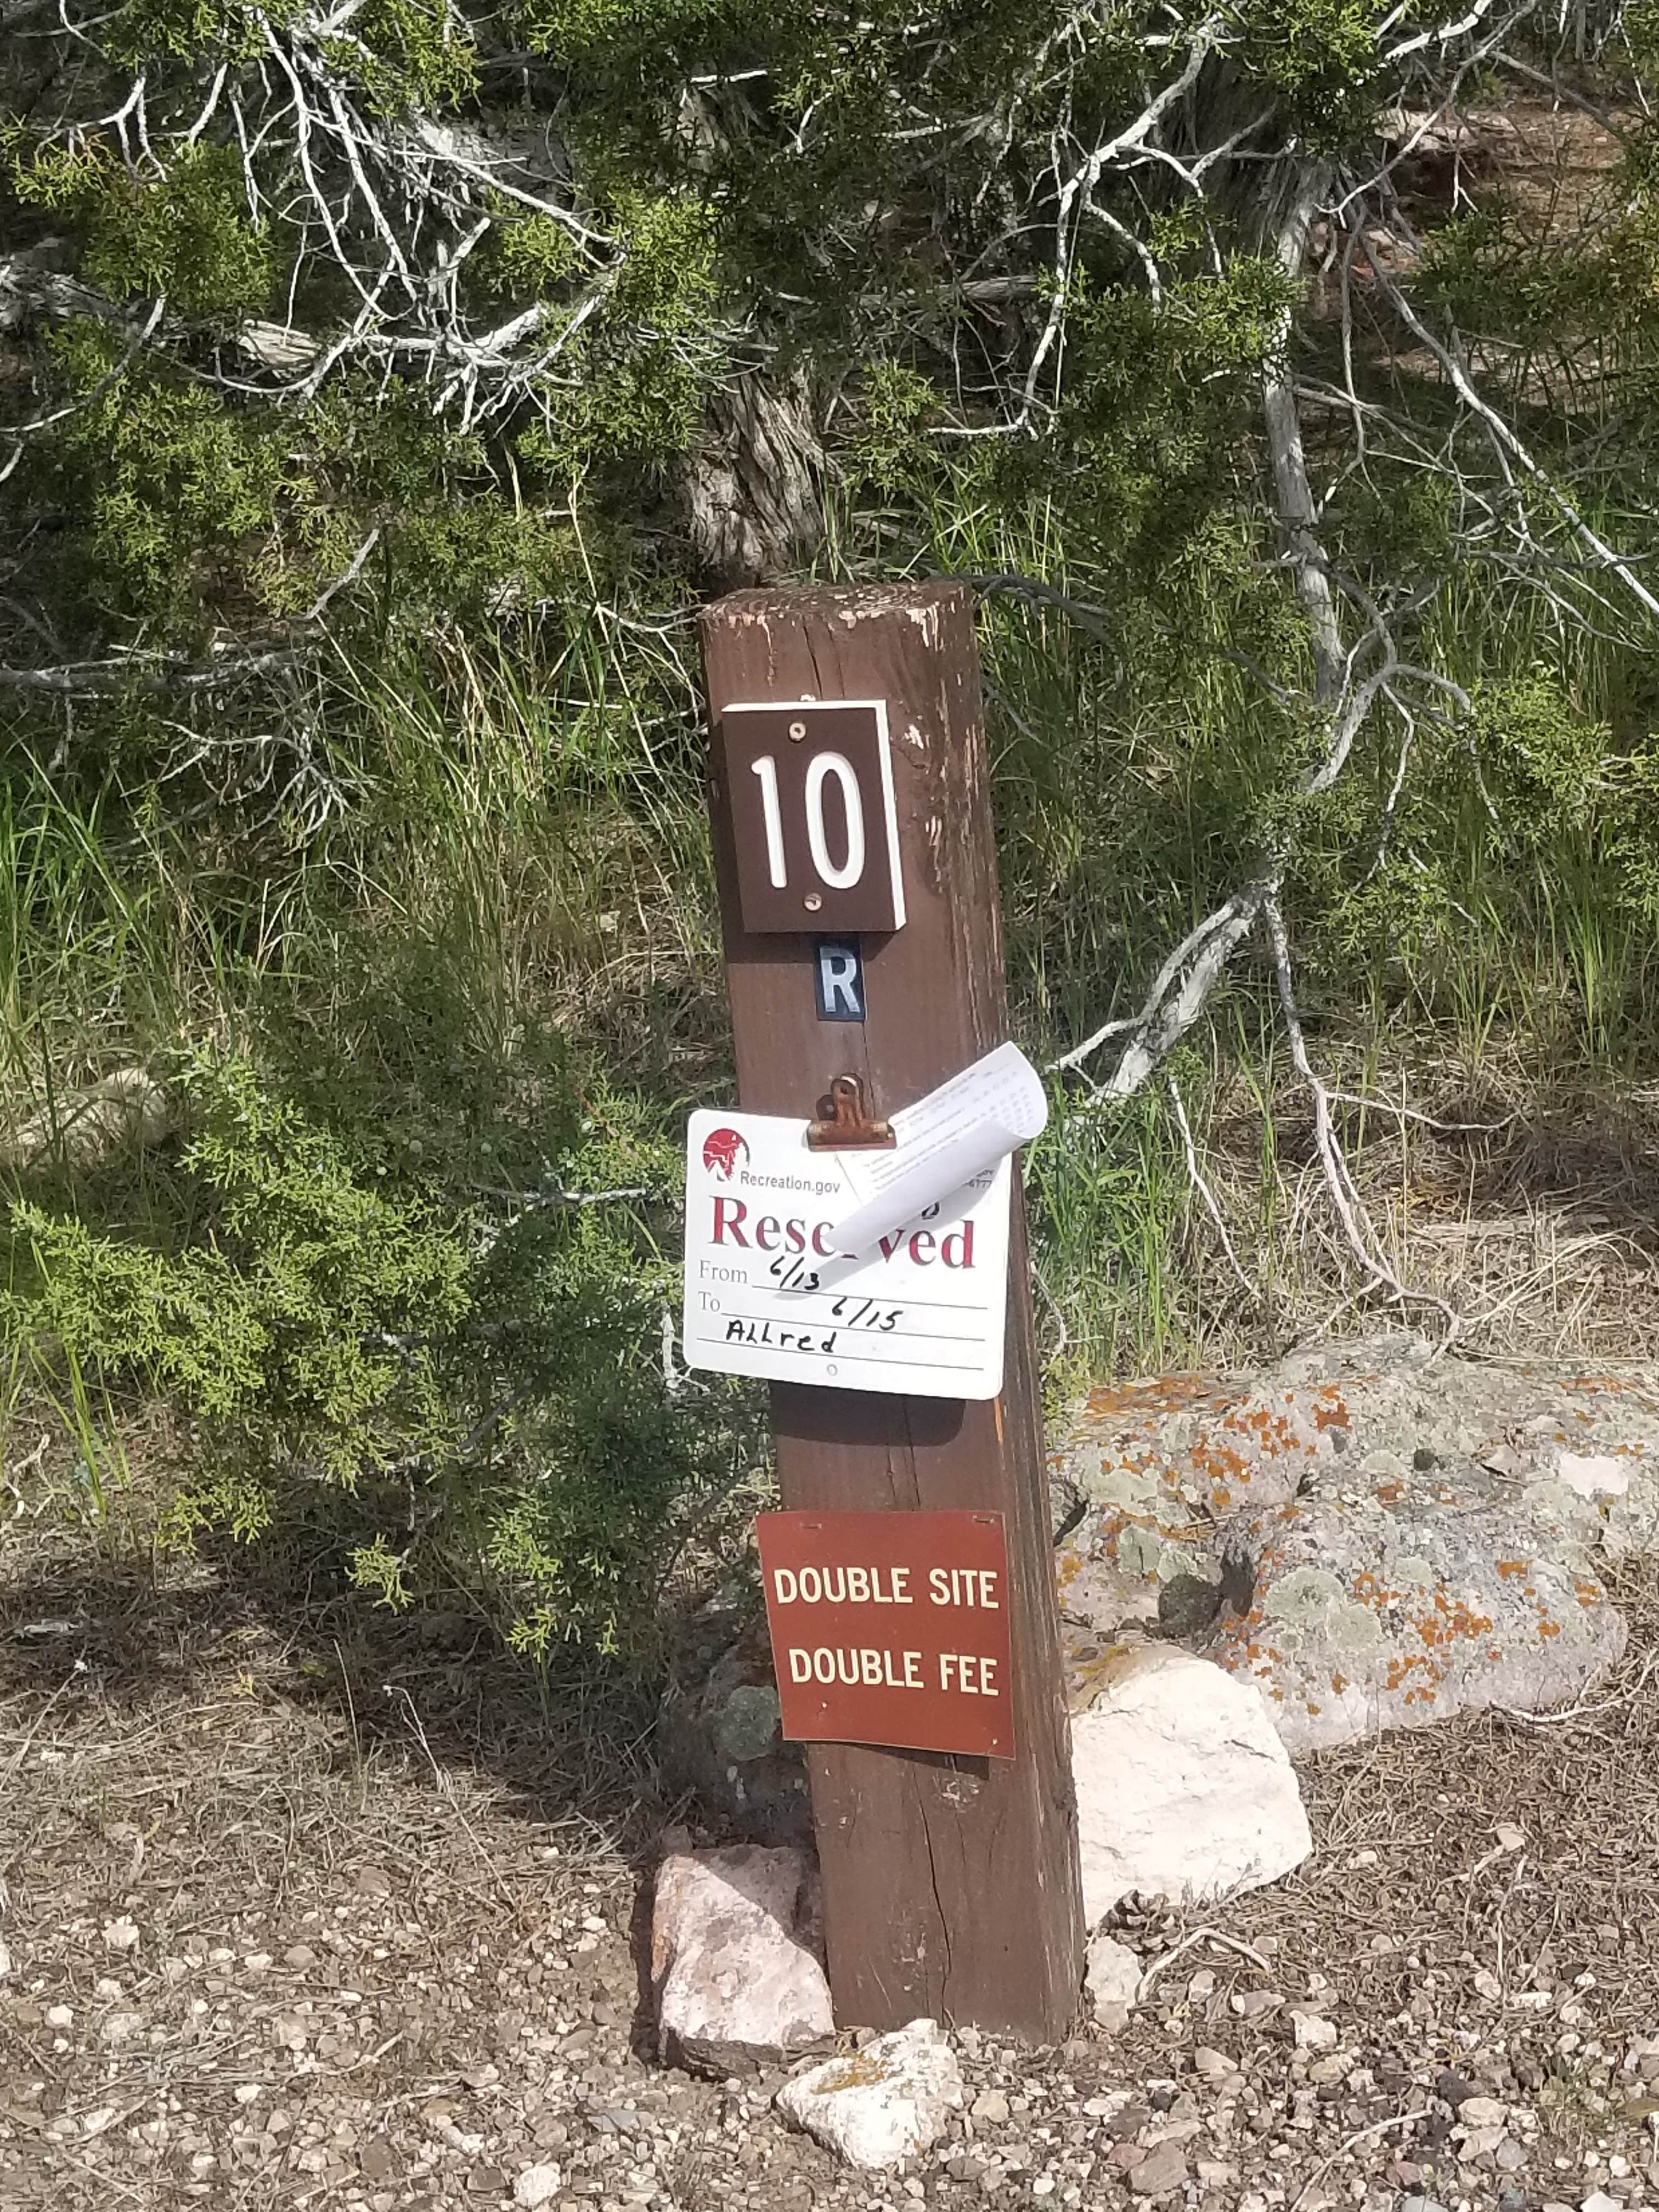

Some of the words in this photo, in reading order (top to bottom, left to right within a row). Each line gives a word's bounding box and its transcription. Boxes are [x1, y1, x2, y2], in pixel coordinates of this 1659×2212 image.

[751, 751, 865, 889] 10
[819, 946, 861, 1013] R
[740, 1170, 841, 1195] Recreation.gov
[708, 1195, 976, 1269] Reseved
[698, 1259, 748, 1284] From
[770, 1255, 820, 1290] 6/13
[698, 1291, 720, 1312] To
[832, 1296, 904, 1331] 6/15
[774, 1567, 913, 1604] DOUBLE
[929, 1568, 1000, 1609] SITE
[788, 1647, 924, 1689] DOUBLE
[939, 1654, 999, 1696] FEE
